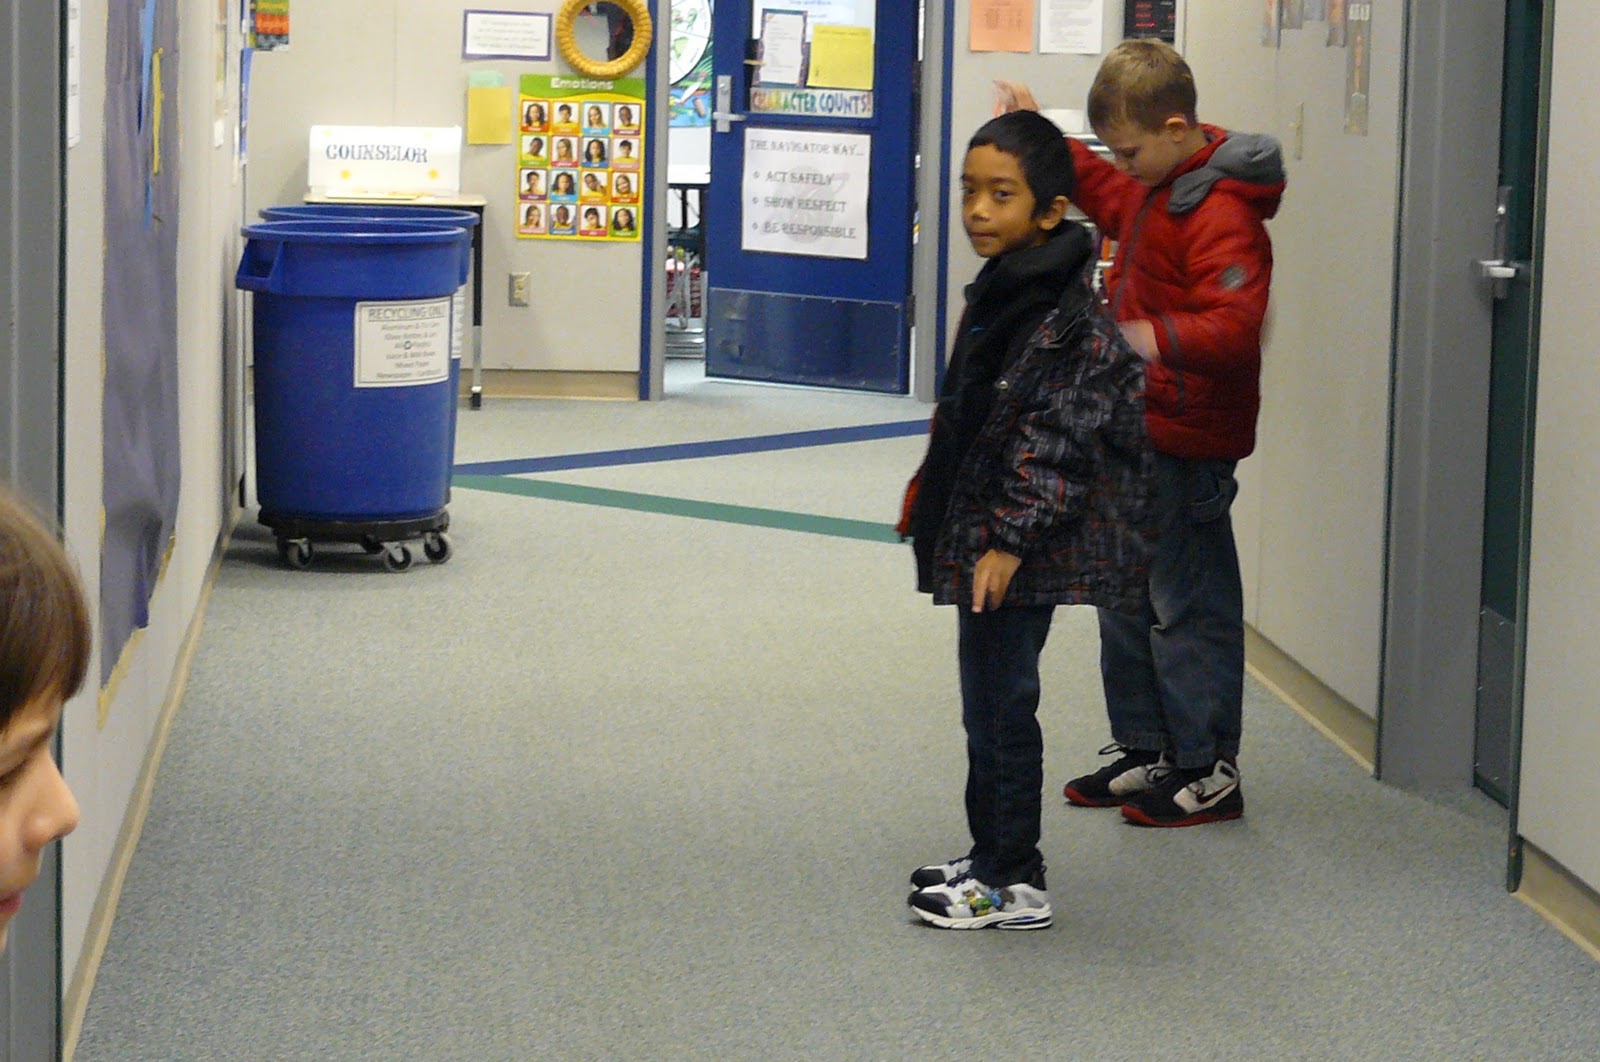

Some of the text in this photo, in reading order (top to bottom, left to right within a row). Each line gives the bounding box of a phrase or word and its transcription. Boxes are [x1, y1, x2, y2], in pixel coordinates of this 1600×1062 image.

[550, 77, 614, 90] Emotions
[751, 90, 872, 115] CHARACTER COUNTS!
[325, 144, 429, 163] COUNSELOR
[750, 139, 768, 151] THE
[770, 140, 830, 155] NAVIGATOR
[766, 171, 836, 186] ACT SAFELY
[763, 196, 848, 213] SHOW RESPECT
[763, 221, 857, 239] BE RESPONSIBLE
[368, 306, 427, 319] RECYCLING
